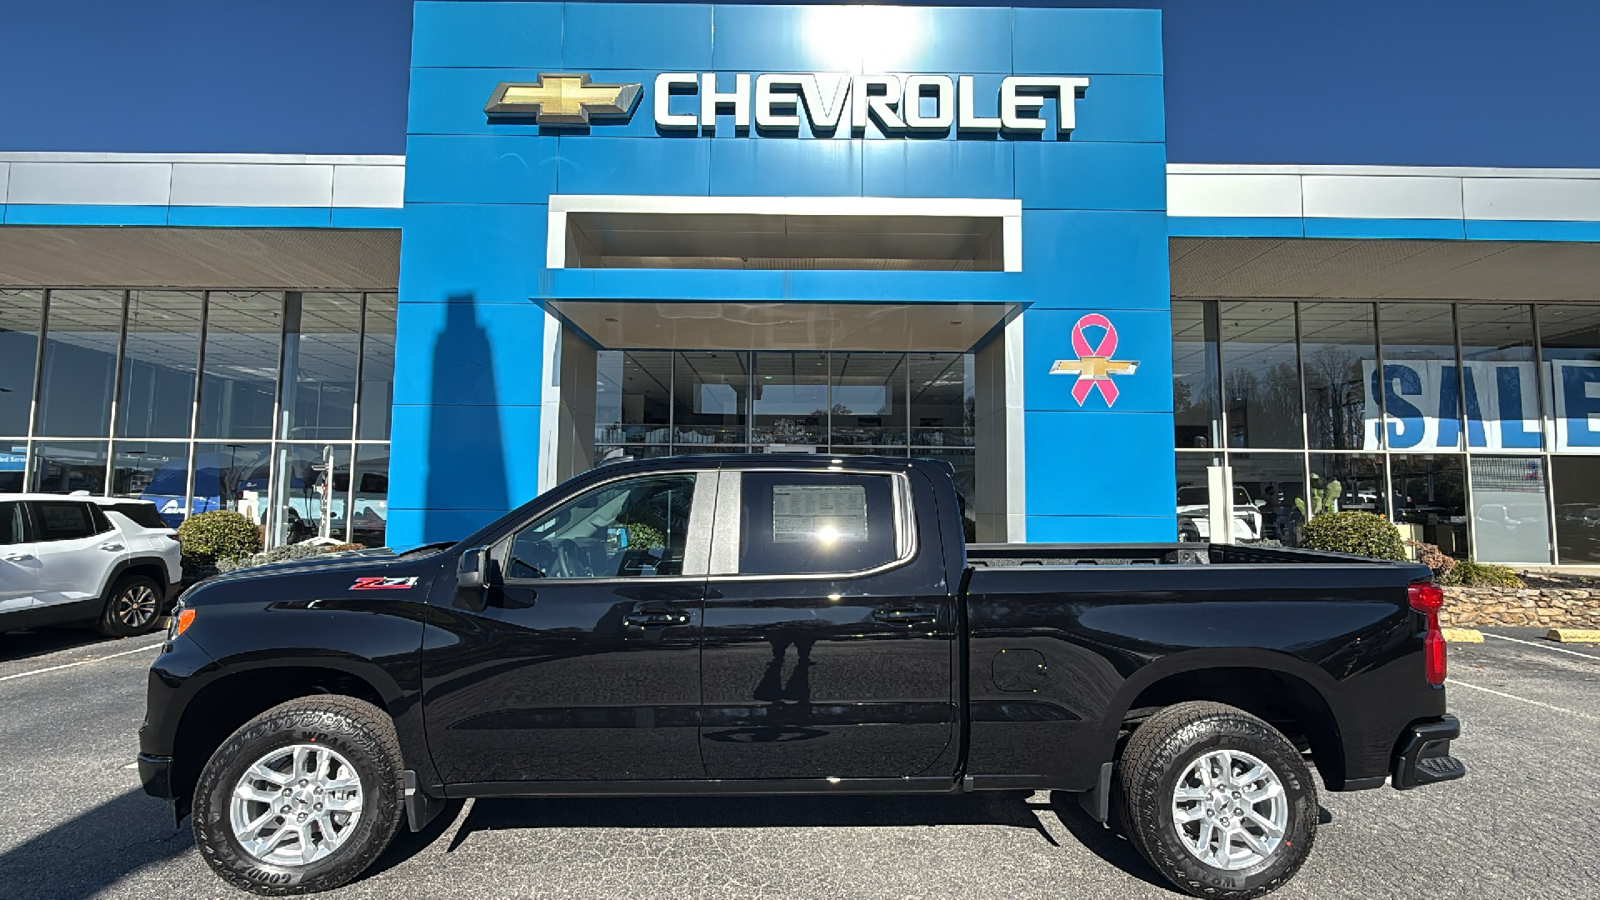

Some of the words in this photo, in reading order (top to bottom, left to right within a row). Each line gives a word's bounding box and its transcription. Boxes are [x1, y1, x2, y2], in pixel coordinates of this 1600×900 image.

[654, 73, 1090, 137] CHEVROLET
[1371, 364, 1600, 449] SALE
[348, 577, 418, 590] Z71
